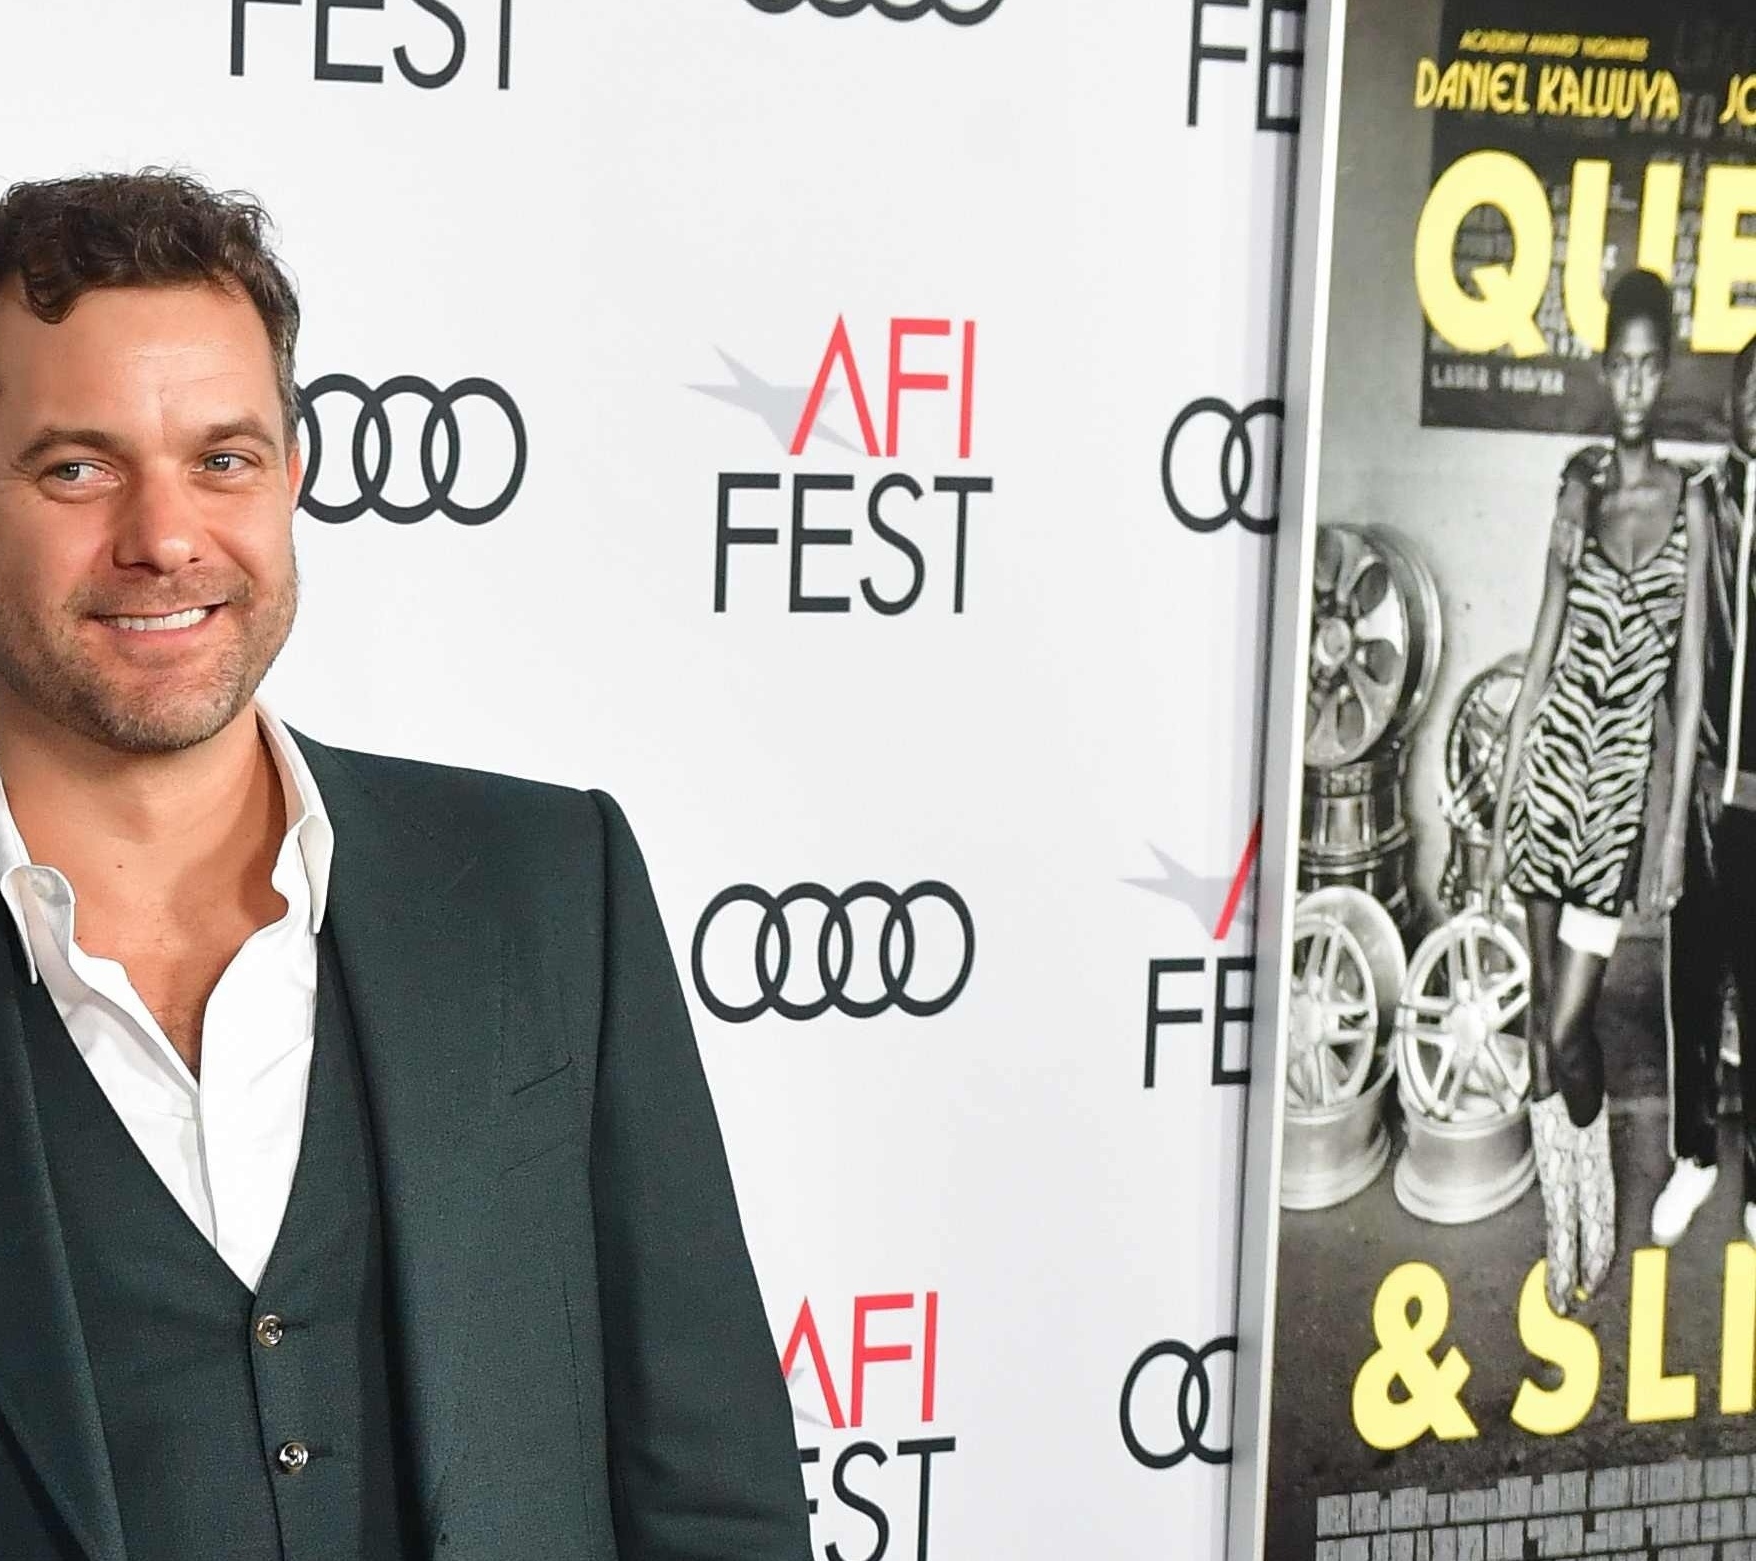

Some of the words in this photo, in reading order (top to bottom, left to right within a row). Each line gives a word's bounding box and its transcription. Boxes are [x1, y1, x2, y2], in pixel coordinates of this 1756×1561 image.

[1188, 0, 1303, 131] FE
[1413, 56, 1531, 115] DANIEL
[1536, 64, 1682, 122] KALUUYA
[791, 316, 975, 458] AFI
[714, 473, 992, 615] FEST
[1144, 957, 1256, 1089] FE
[779, 1291, 938, 1429] AFI
[1351, 1259, 1481, 1451] &
